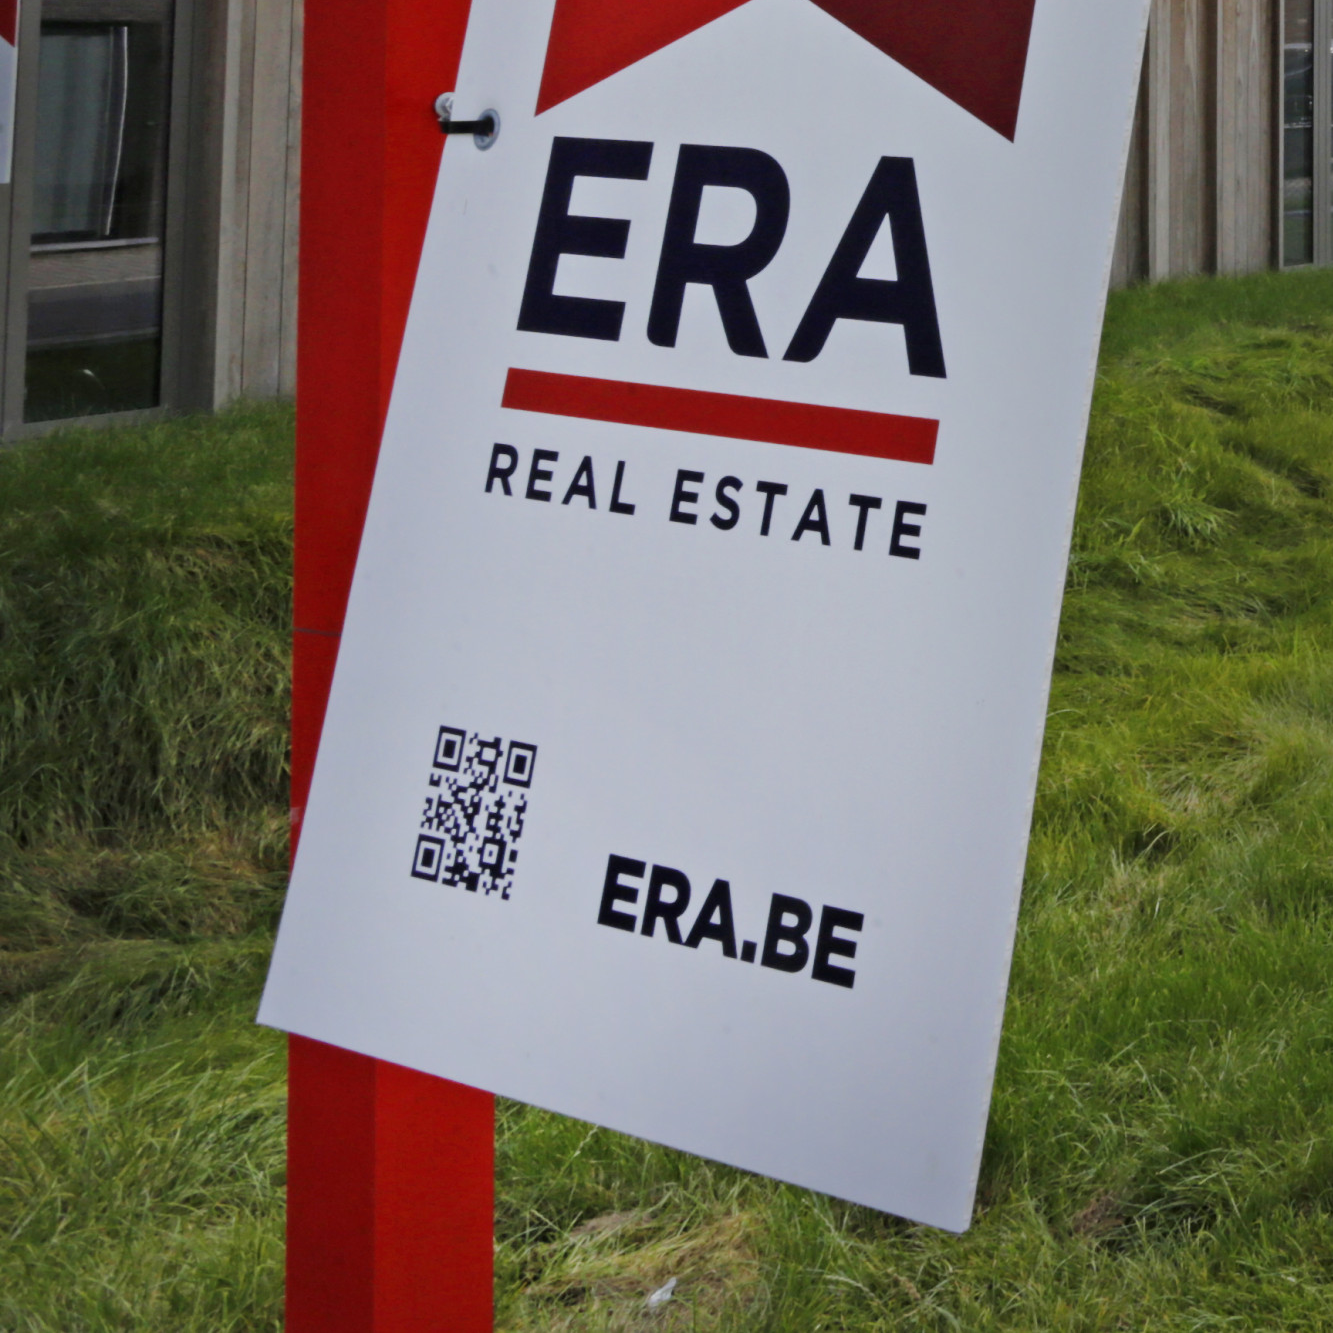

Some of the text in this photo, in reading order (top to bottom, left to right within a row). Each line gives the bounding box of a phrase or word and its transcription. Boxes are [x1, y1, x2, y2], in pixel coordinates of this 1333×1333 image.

[516, 136, 947, 379] ERA
[484, 442, 928, 560] REAL ESTATE
[597, 853, 865, 989] ERA.BE
